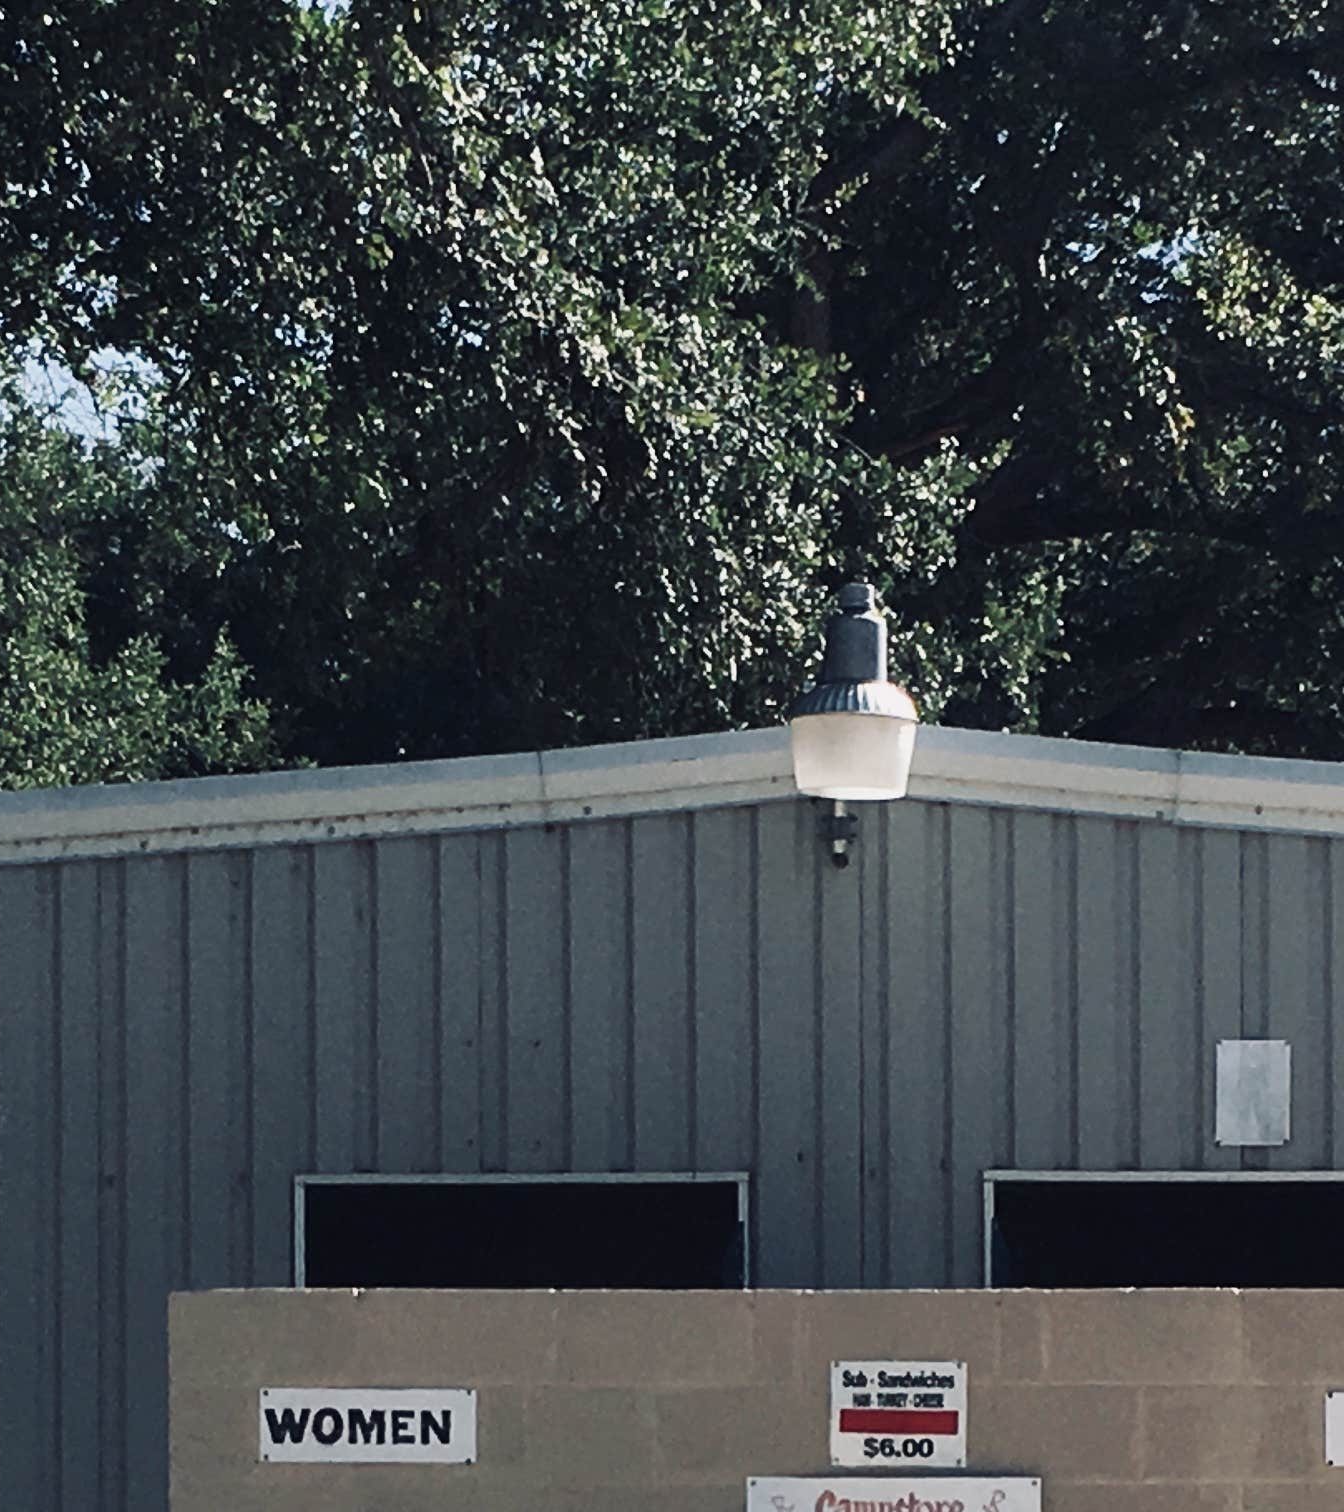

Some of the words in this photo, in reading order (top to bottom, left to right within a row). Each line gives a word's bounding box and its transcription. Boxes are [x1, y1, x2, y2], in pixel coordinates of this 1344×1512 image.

[842, 1370, 868, 1388] Sub
[877, 1370, 955, 1389] Sandwiches
[264, 1407, 451, 1445] WOMEN
[863, 1437, 934, 1459] $6.00
